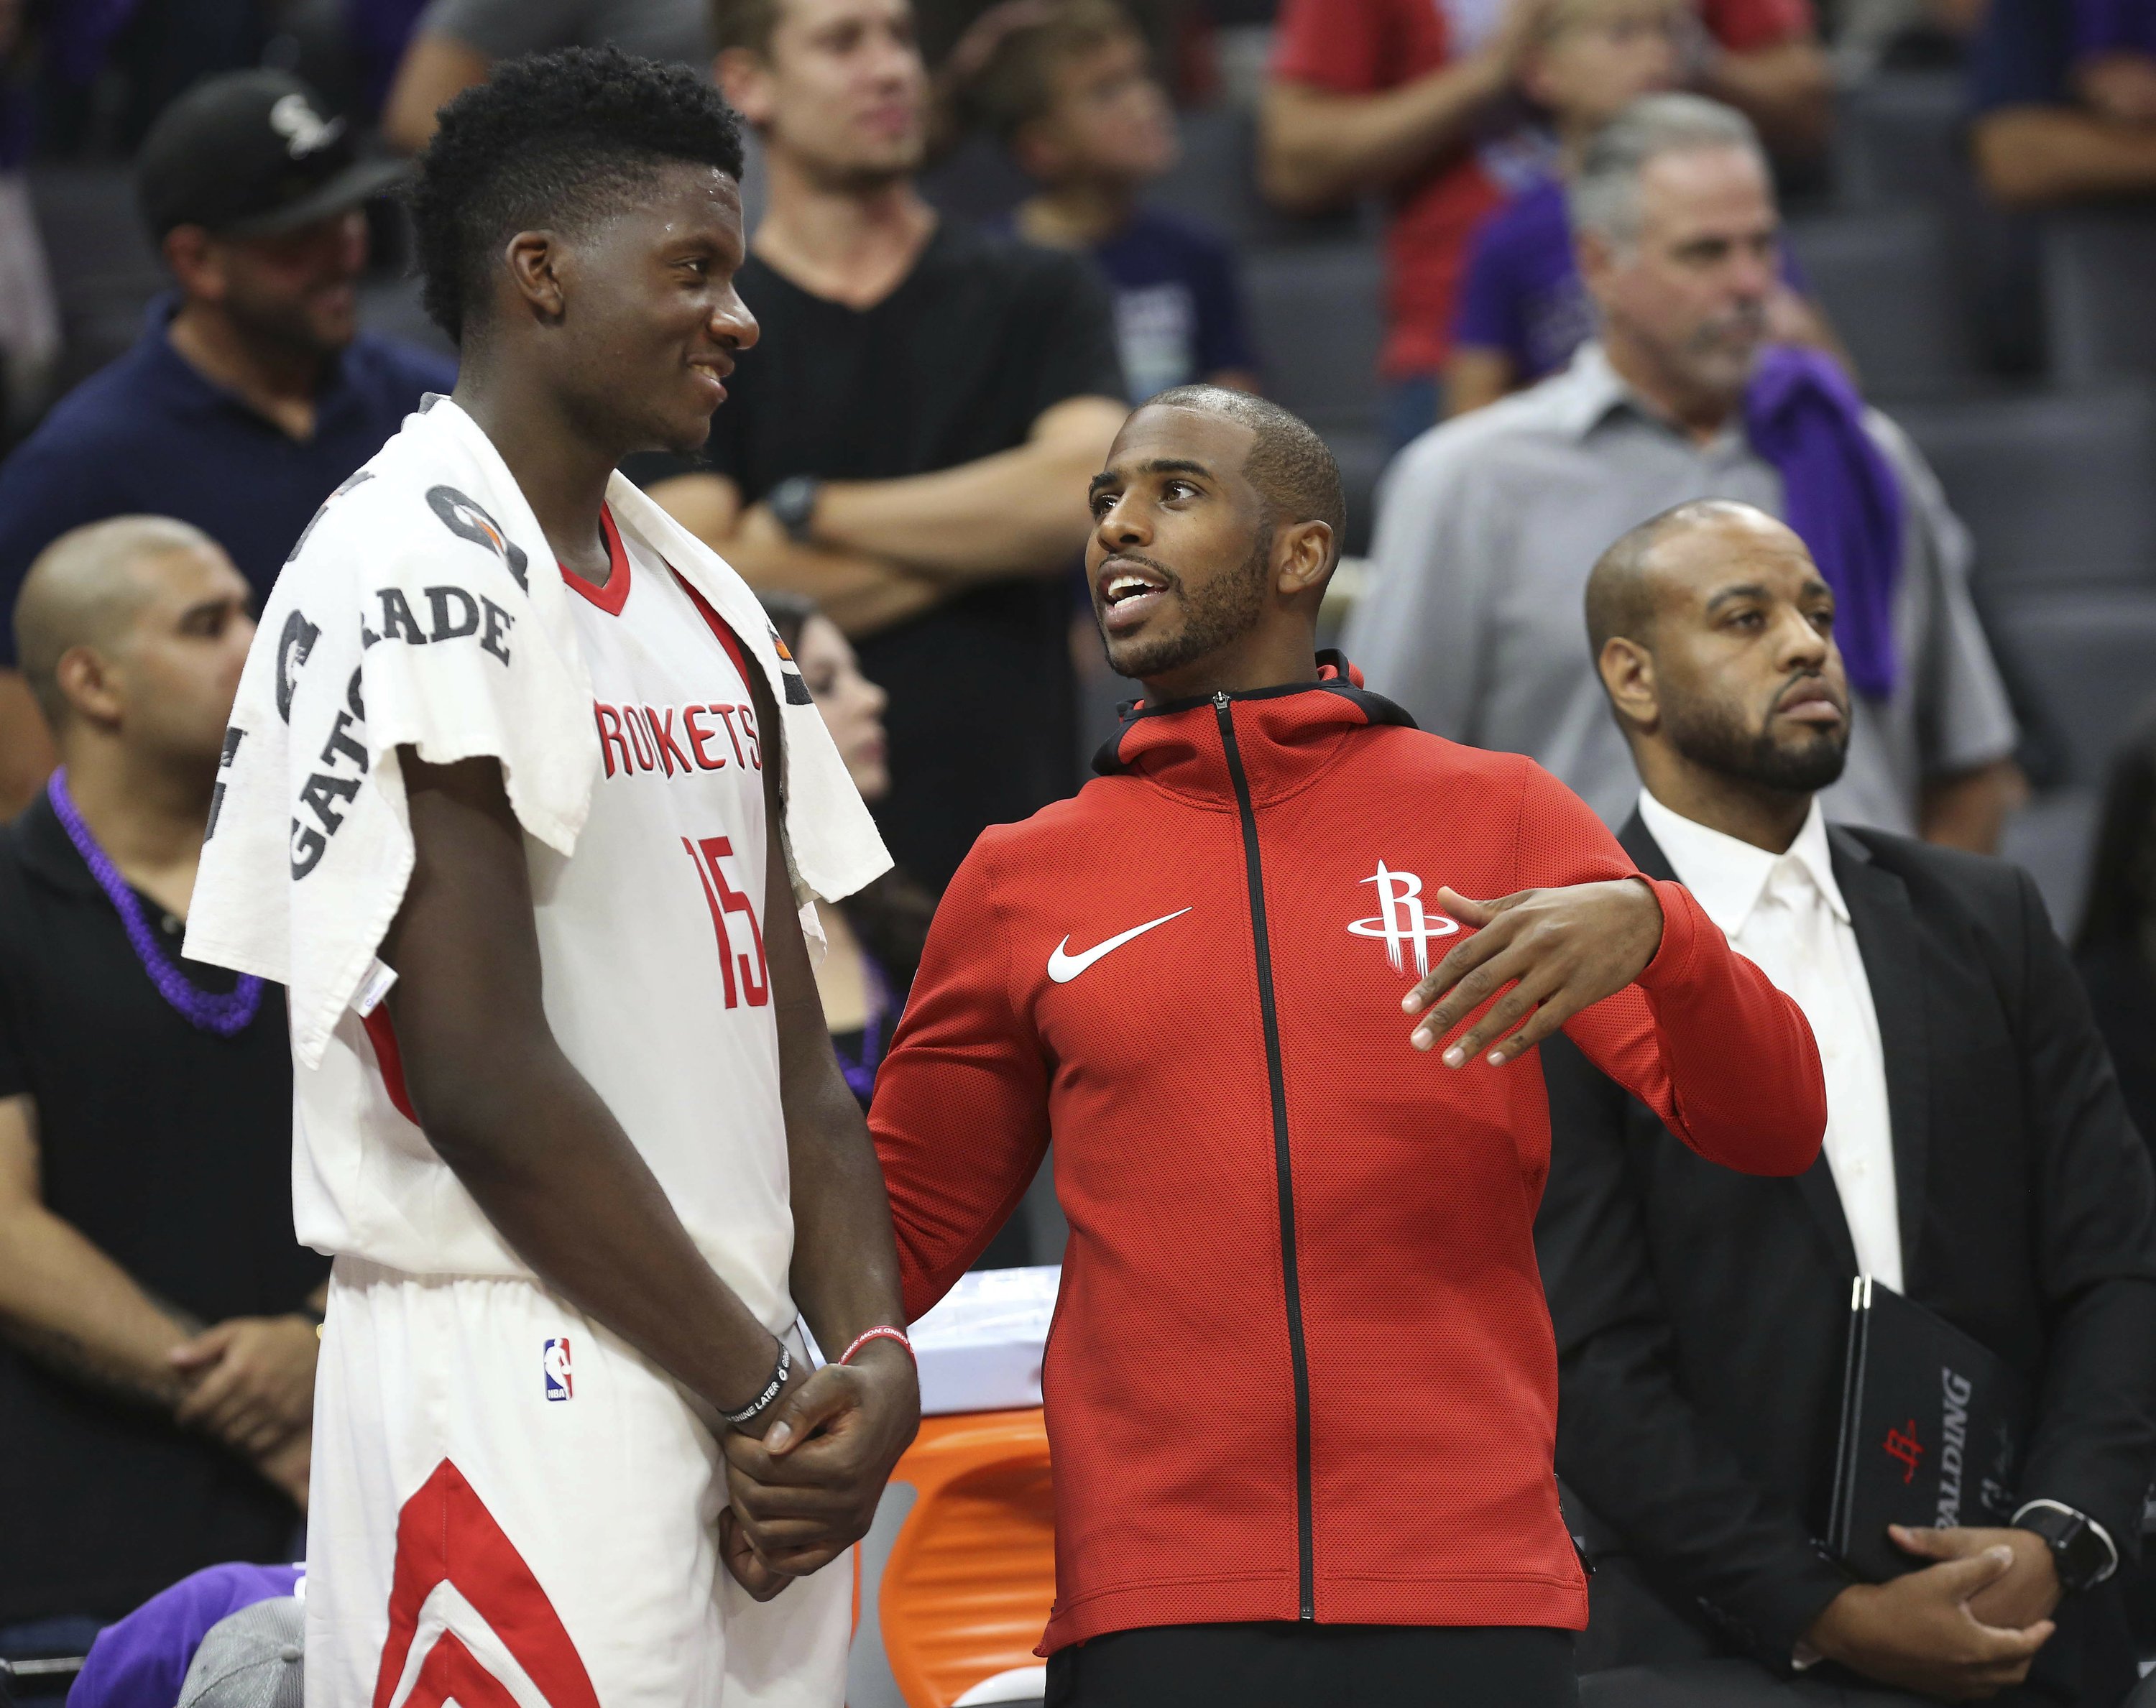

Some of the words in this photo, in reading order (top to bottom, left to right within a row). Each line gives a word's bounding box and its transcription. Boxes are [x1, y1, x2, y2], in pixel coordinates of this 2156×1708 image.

[594, 697, 763, 780] ROKETS
[681, 835, 768, 1010] 15
[859, 1327, 883, 1342] NOW
[547, 1388, 565, 1398] NBA
[755, 1381, 780, 1410] LATER
